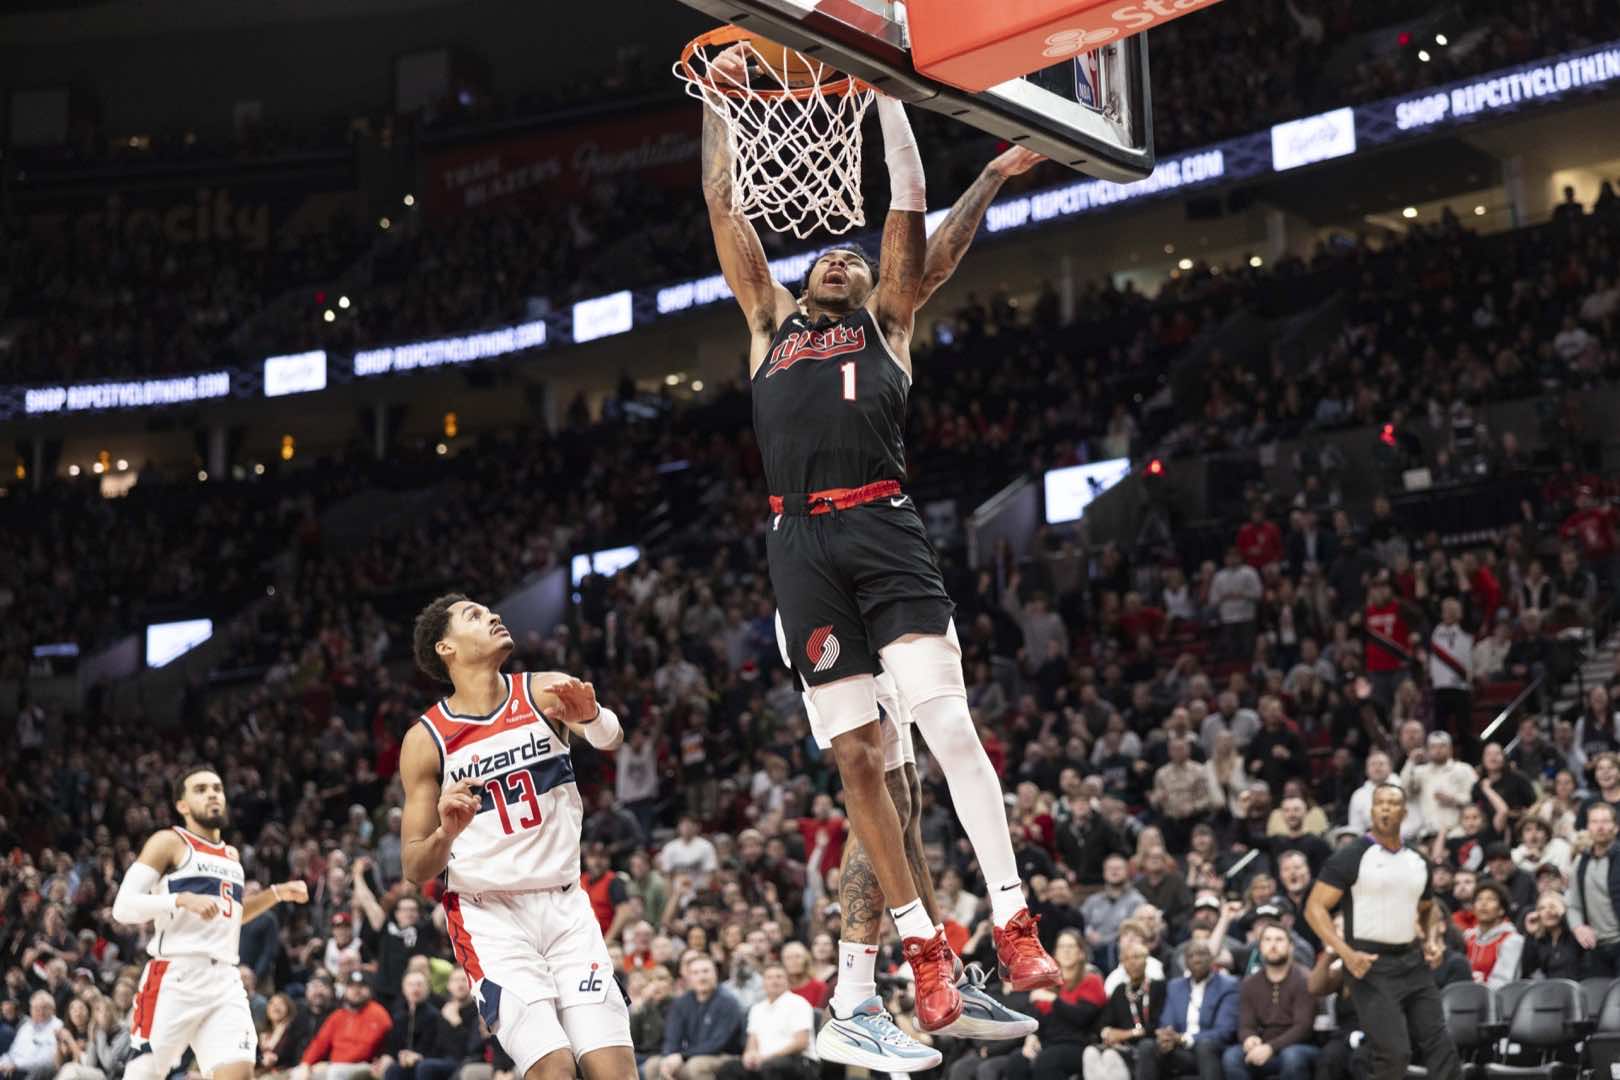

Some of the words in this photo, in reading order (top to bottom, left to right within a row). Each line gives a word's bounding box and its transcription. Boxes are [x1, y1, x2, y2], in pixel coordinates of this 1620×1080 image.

[1396, 93, 1450, 130] SHOP
[986, 198, 1030, 232] SHOP
[656, 285, 694, 314] SHOP
[353, 349, 392, 376] SHOP
[25, 386, 66, 413] SHOP
[839, 361, 857, 402] 1
[450, 732, 551, 783] wizards
[485, 769, 543, 836] 13
[221, 881, 234, 918] 5
